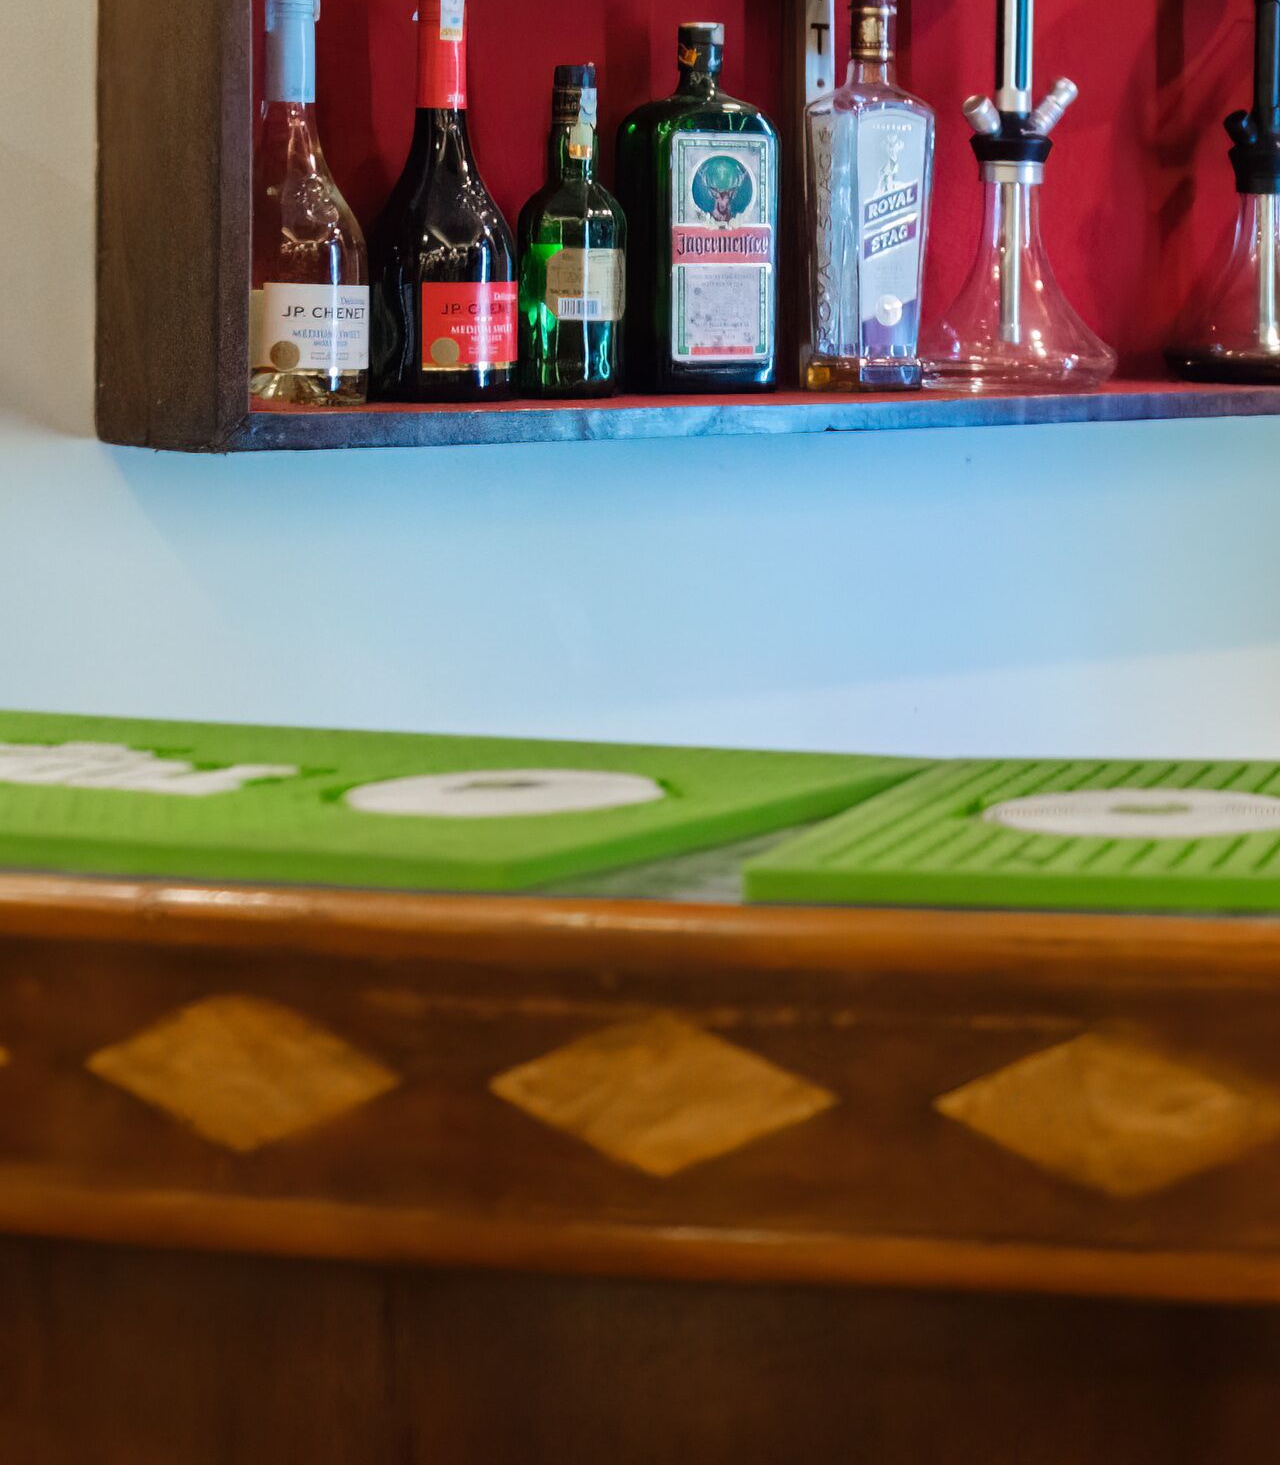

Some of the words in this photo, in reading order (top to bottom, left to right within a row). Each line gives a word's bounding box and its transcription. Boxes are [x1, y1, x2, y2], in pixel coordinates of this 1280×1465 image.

[868, 189, 916, 220] ROYAL
[870, 226, 909, 254] STAG
[311, 307, 366, 320] CHENET
